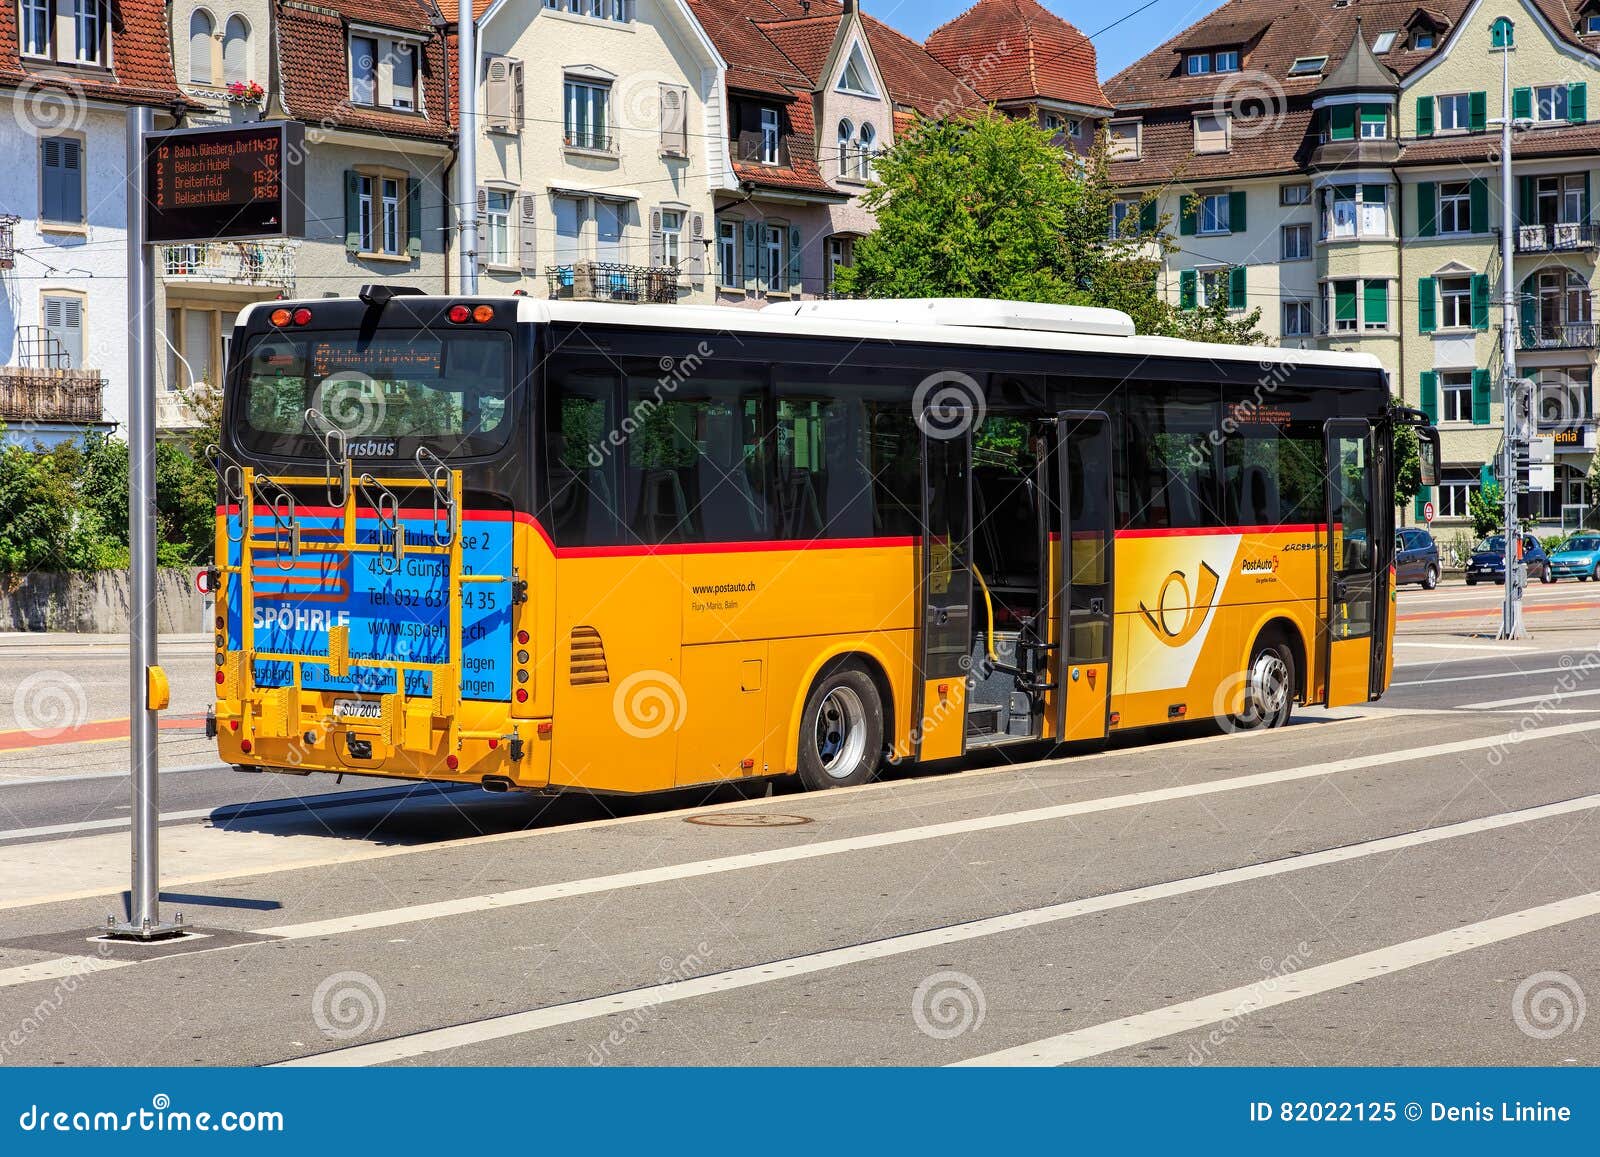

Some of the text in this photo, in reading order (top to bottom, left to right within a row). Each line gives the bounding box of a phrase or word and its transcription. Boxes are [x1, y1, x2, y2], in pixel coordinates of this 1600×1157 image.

[158, 146, 169, 159] 12
[174, 145, 191, 158] Balm
[236, 140, 252, 153] Dorf
[253, 137, 279, 152] 14:37
[156, 162, 164, 175] 2
[175, 160, 206, 173] Bellach
[156, 178, 164, 190] 3
[175, 173, 223, 188] Breitenfeld
[157, 193, 164, 206] 2
[175, 190, 206, 204] Bellach
[253, 185, 278, 199] 15:52
[481, 531, 490, 550] 2
[1242, 559, 1272, 571] PostAuto
[692, 580, 756, 596] www.postauto.ch
[394, 588, 420, 607] 032
[425, 590, 450, 608] 637
[478, 592, 496, 610] 35
